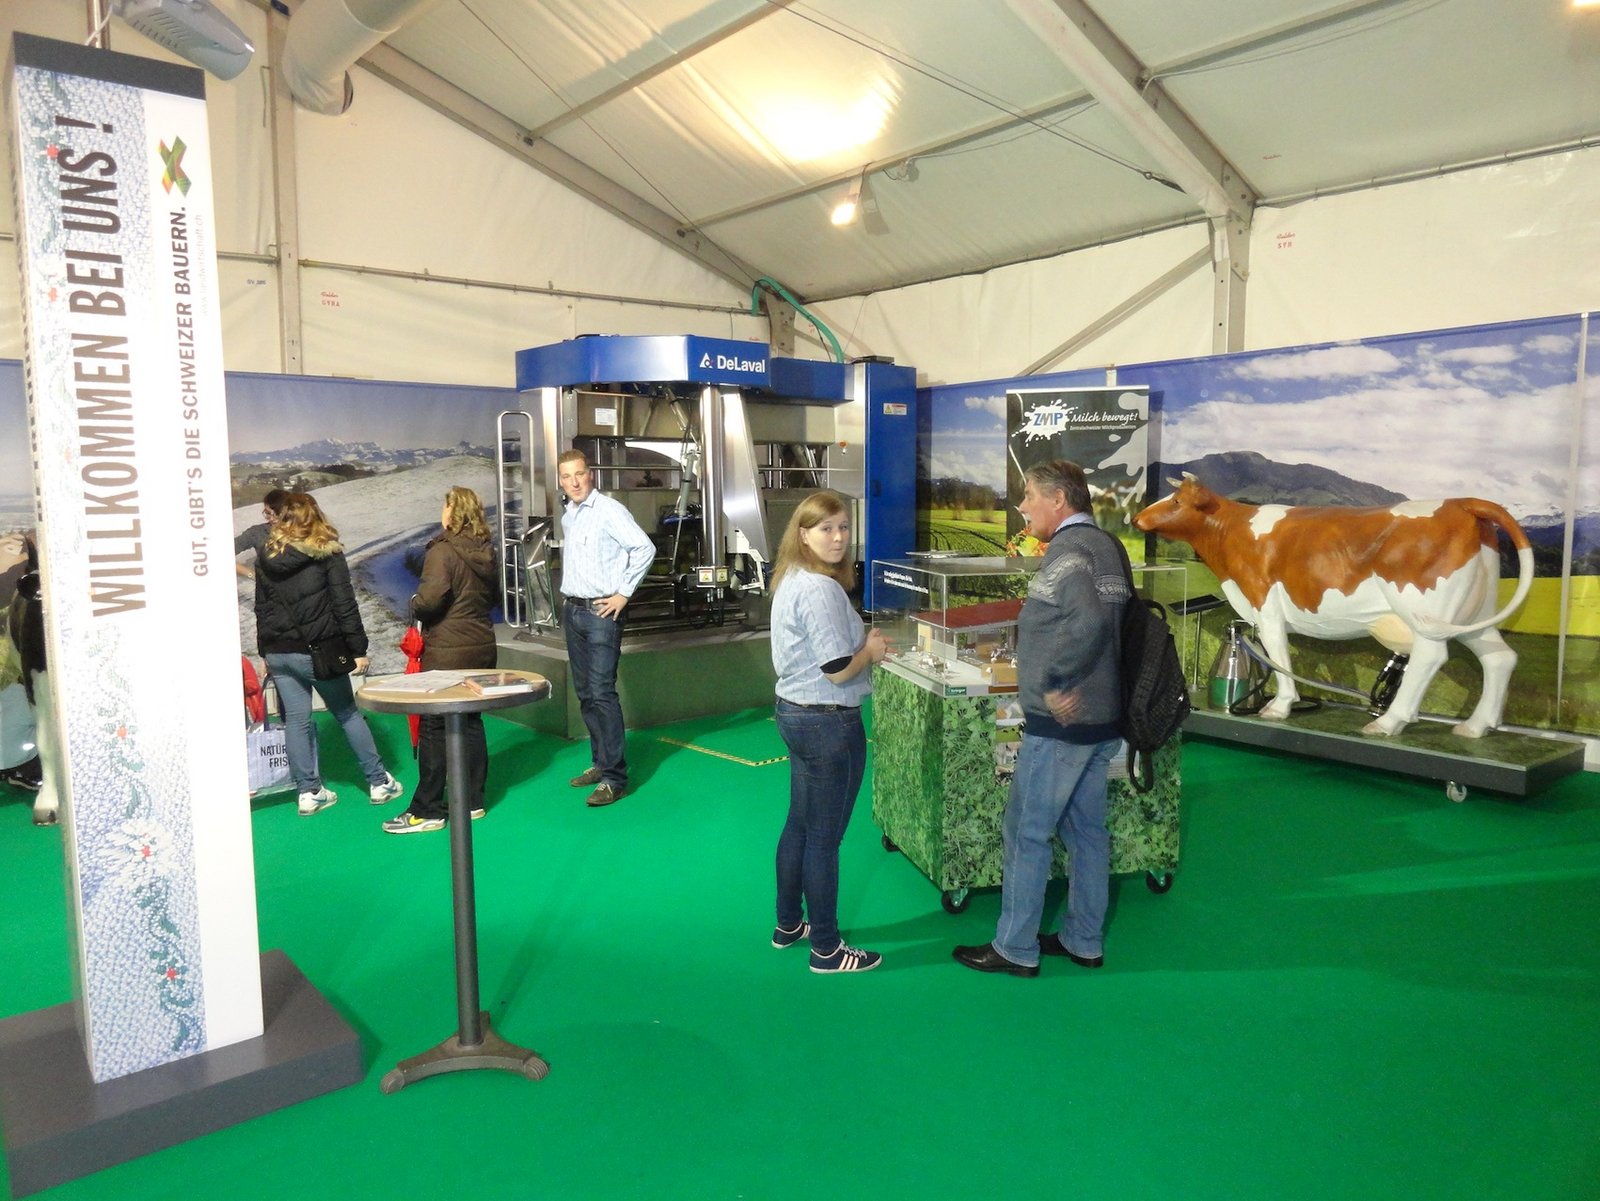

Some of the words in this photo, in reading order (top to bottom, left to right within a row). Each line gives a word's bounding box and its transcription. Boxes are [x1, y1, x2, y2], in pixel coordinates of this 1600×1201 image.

[57, 148, 121, 235] UNS
[169, 206, 191, 294] BAUERN.
[64, 249, 128, 317] BEI
[177, 302, 200, 420] SCHWEIZER
[717, 355, 765, 373] DeLaval
[184, 428, 202, 460] DIE
[1033, 412, 1064, 426] ZMP
[1071, 411, 1101, 423] Milch
[1100, 410, 1138, 426] bewegt!
[72, 333, 147, 617] WILLKOMMEN
[187, 467, 206, 530] GIBT'S
[191, 534, 208, 577] GUT,
[269, 757, 290, 768] FRIS
